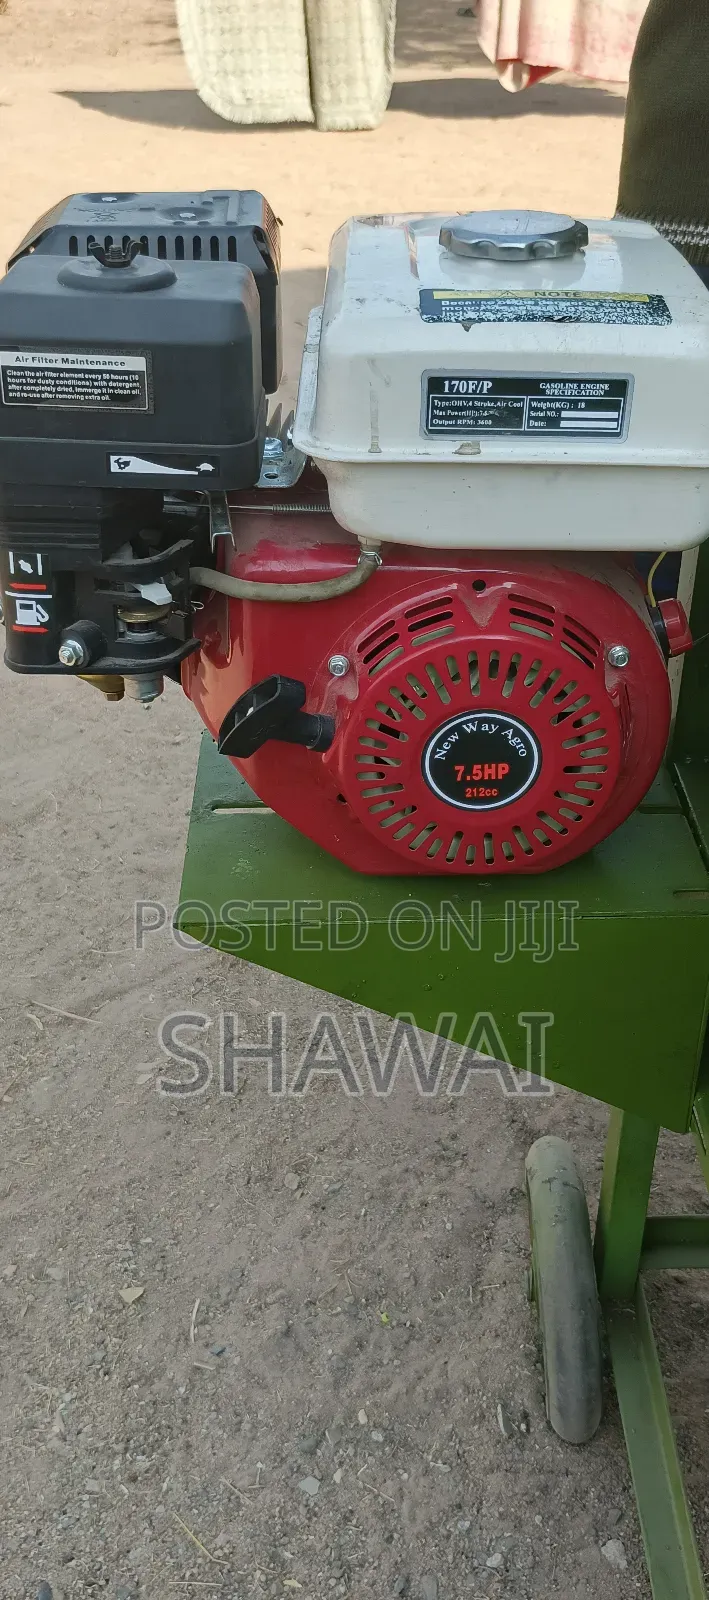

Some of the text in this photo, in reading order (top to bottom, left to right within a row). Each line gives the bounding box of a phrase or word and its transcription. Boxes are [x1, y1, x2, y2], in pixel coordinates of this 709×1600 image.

[14, 355, 126, 367] Air Filter Maintenance
[60, 371, 84, 379] element
[56, 379, 92, 387] conditions)
[443, 380, 493, 394] 170F/P
[539, 382, 579, 390] GASOLINE
[56, 393, 84, 401] removing
[432, 418, 456, 426] Output
[529, 419, 547, 427] Date:
[434, 720, 527, 760] New Way Agro
[454, 763, 510, 782] 7.5HP
[465, 787, 499, 798] 212cc
